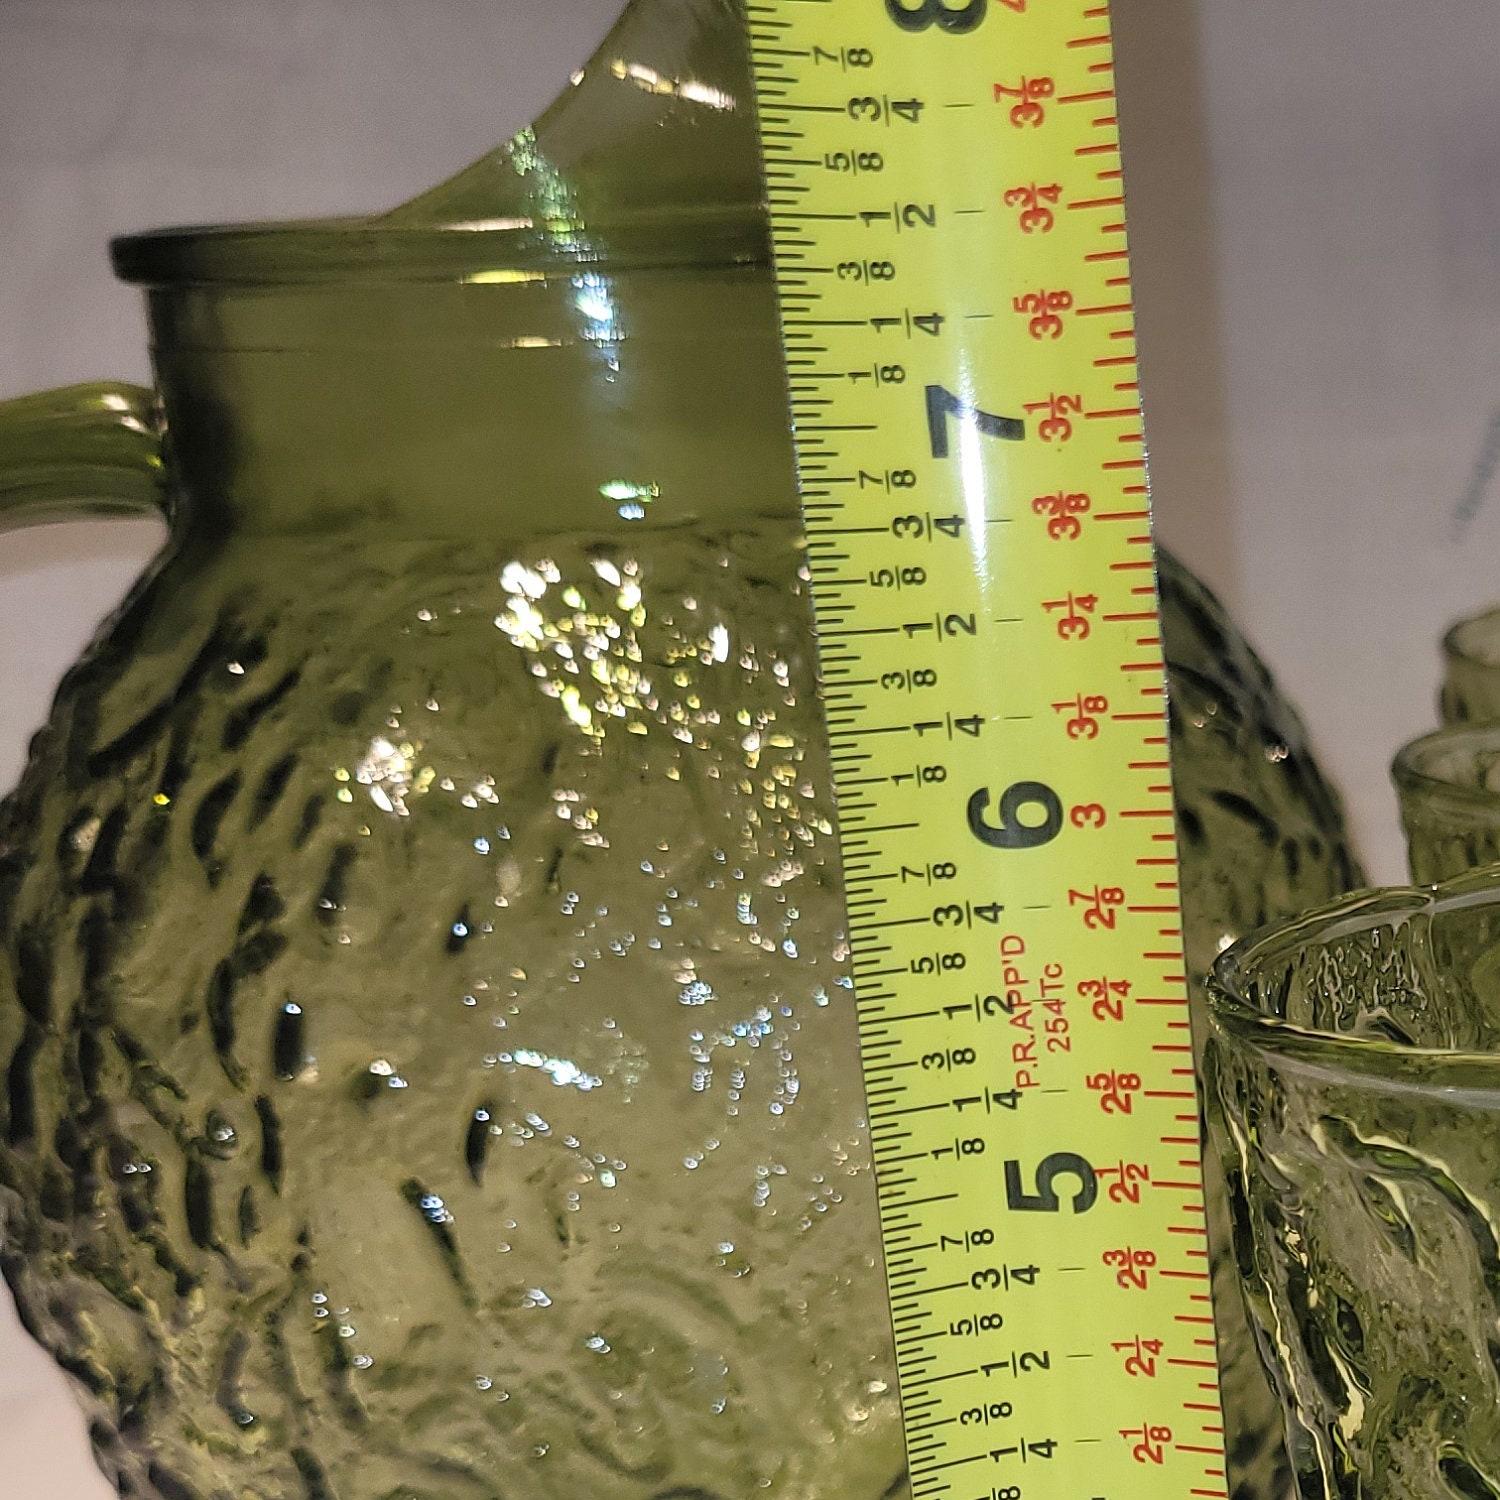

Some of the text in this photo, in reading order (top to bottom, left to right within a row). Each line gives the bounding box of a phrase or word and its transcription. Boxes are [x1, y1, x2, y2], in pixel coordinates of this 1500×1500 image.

[925, 384, 1026, 458] 7
[967, 780, 1064, 849] 6
[1070, 803, 1107, 828] 3
[1003, 1152, 1098, 1214] 5
